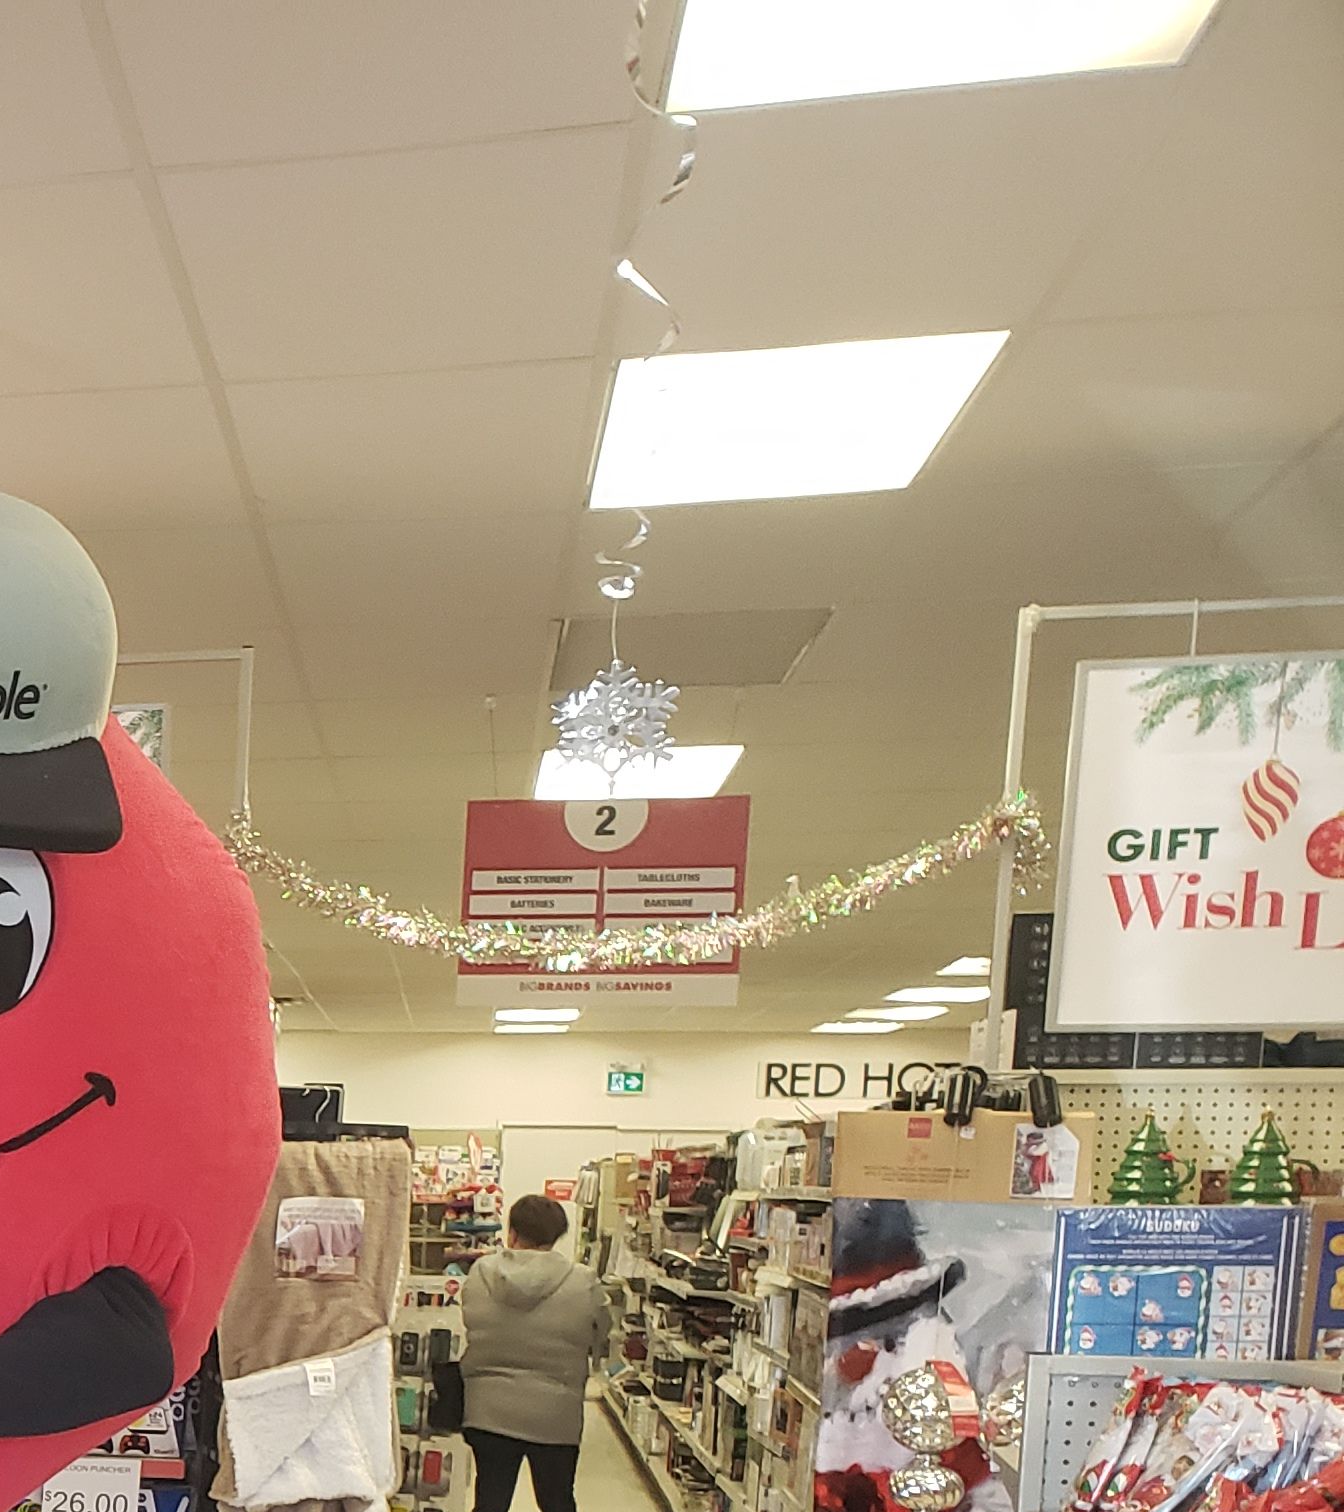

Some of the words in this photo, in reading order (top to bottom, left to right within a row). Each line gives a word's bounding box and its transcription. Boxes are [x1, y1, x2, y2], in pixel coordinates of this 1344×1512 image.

[595, 806, 617, 836] 2
[1107, 827, 1219, 862] GIFT
[1103, 870, 1286, 931] Wish
[765, 1063, 845, 1098] RED
[1146, 1219, 1200, 1232] SUDOKU
[90, 1464, 131, 1473] PUNCHER
